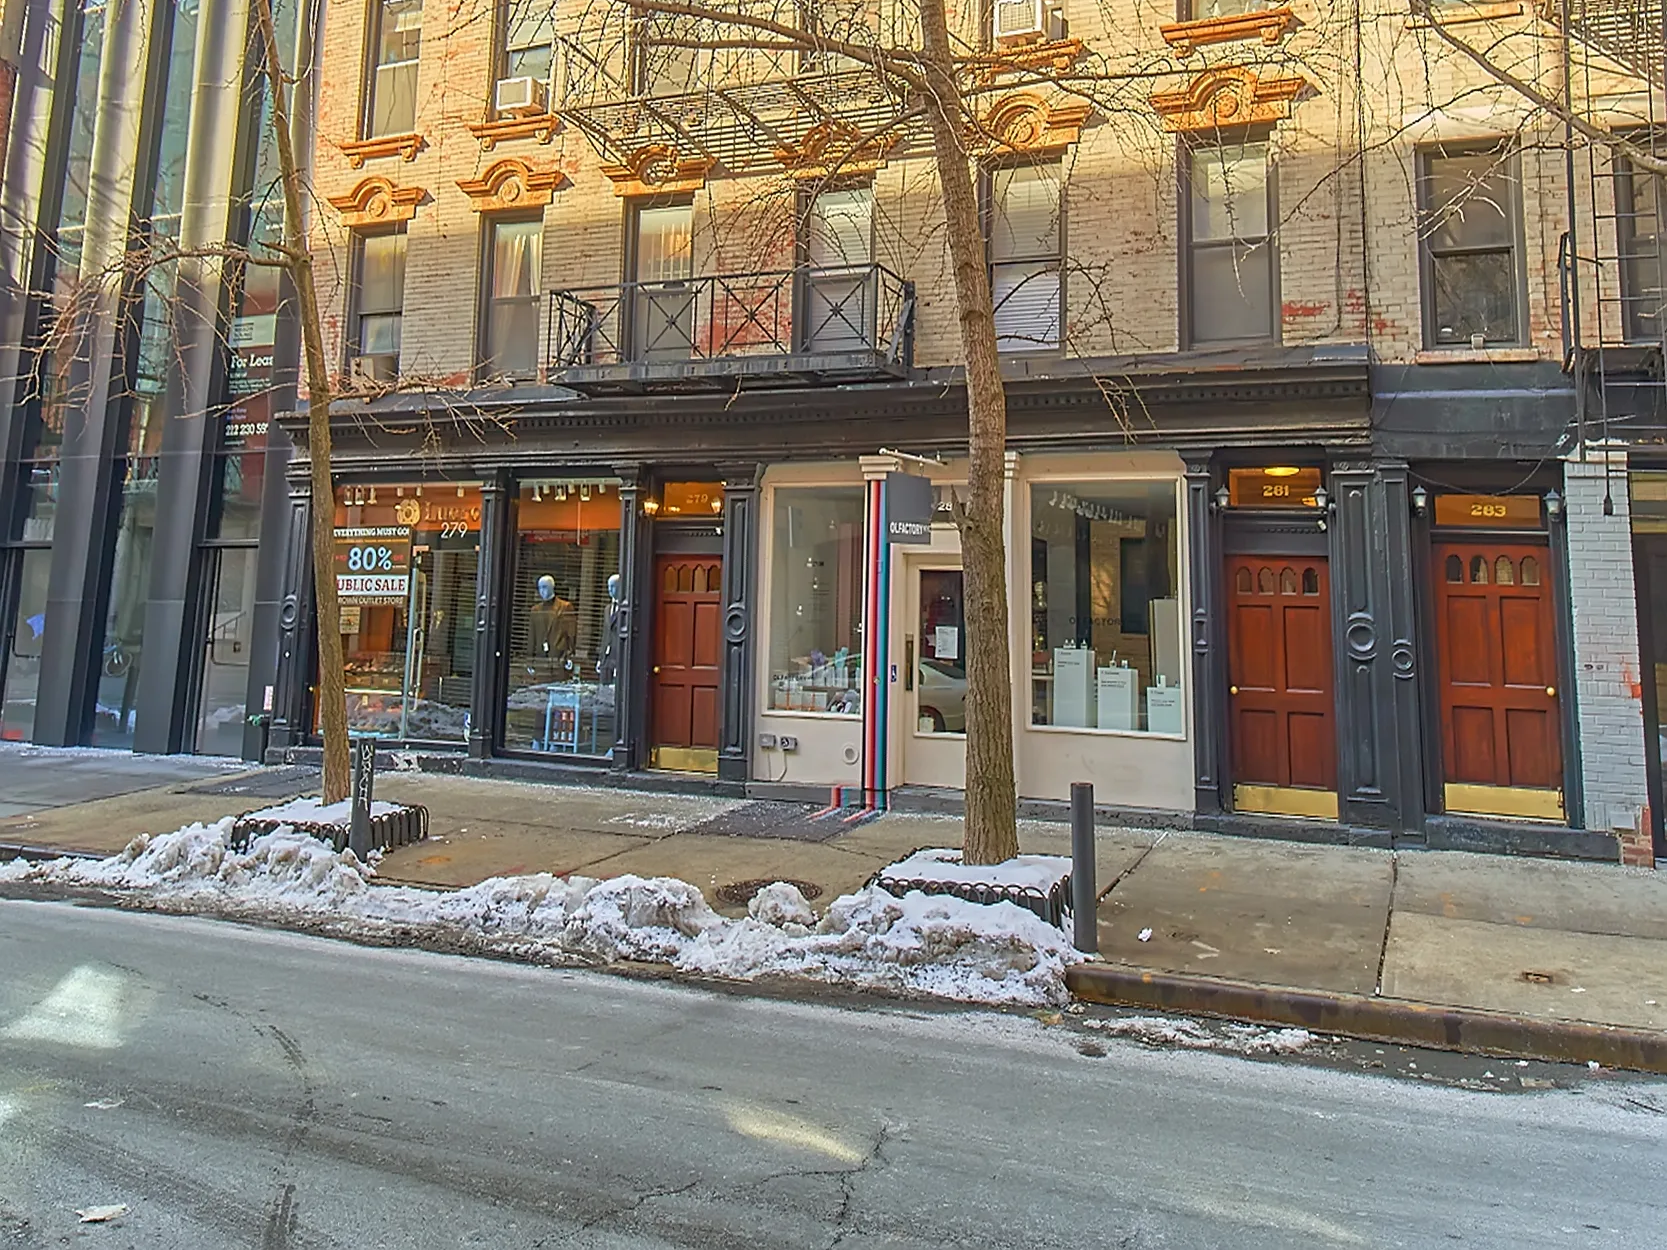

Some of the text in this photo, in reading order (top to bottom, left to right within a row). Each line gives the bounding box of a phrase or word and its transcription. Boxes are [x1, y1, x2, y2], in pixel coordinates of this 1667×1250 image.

[226, 424, 239, 436] 212
[240, 422, 255, 435] 230
[1263, 485, 1289, 497] 281
[686, 494, 708, 504] 279
[937, 502, 953, 511] 28
[1471, 505, 1506, 517] 283
[376, 527, 397, 536] MUST
[441, 522, 468, 538] 279
[889, 521, 923, 535] OLFACTORY
[348, 546, 392, 571] 80%
[336, 578, 406, 592] UBLIC SALE
[359, 596, 382, 605] OUTLET
[383, 596, 404, 605] STORE
